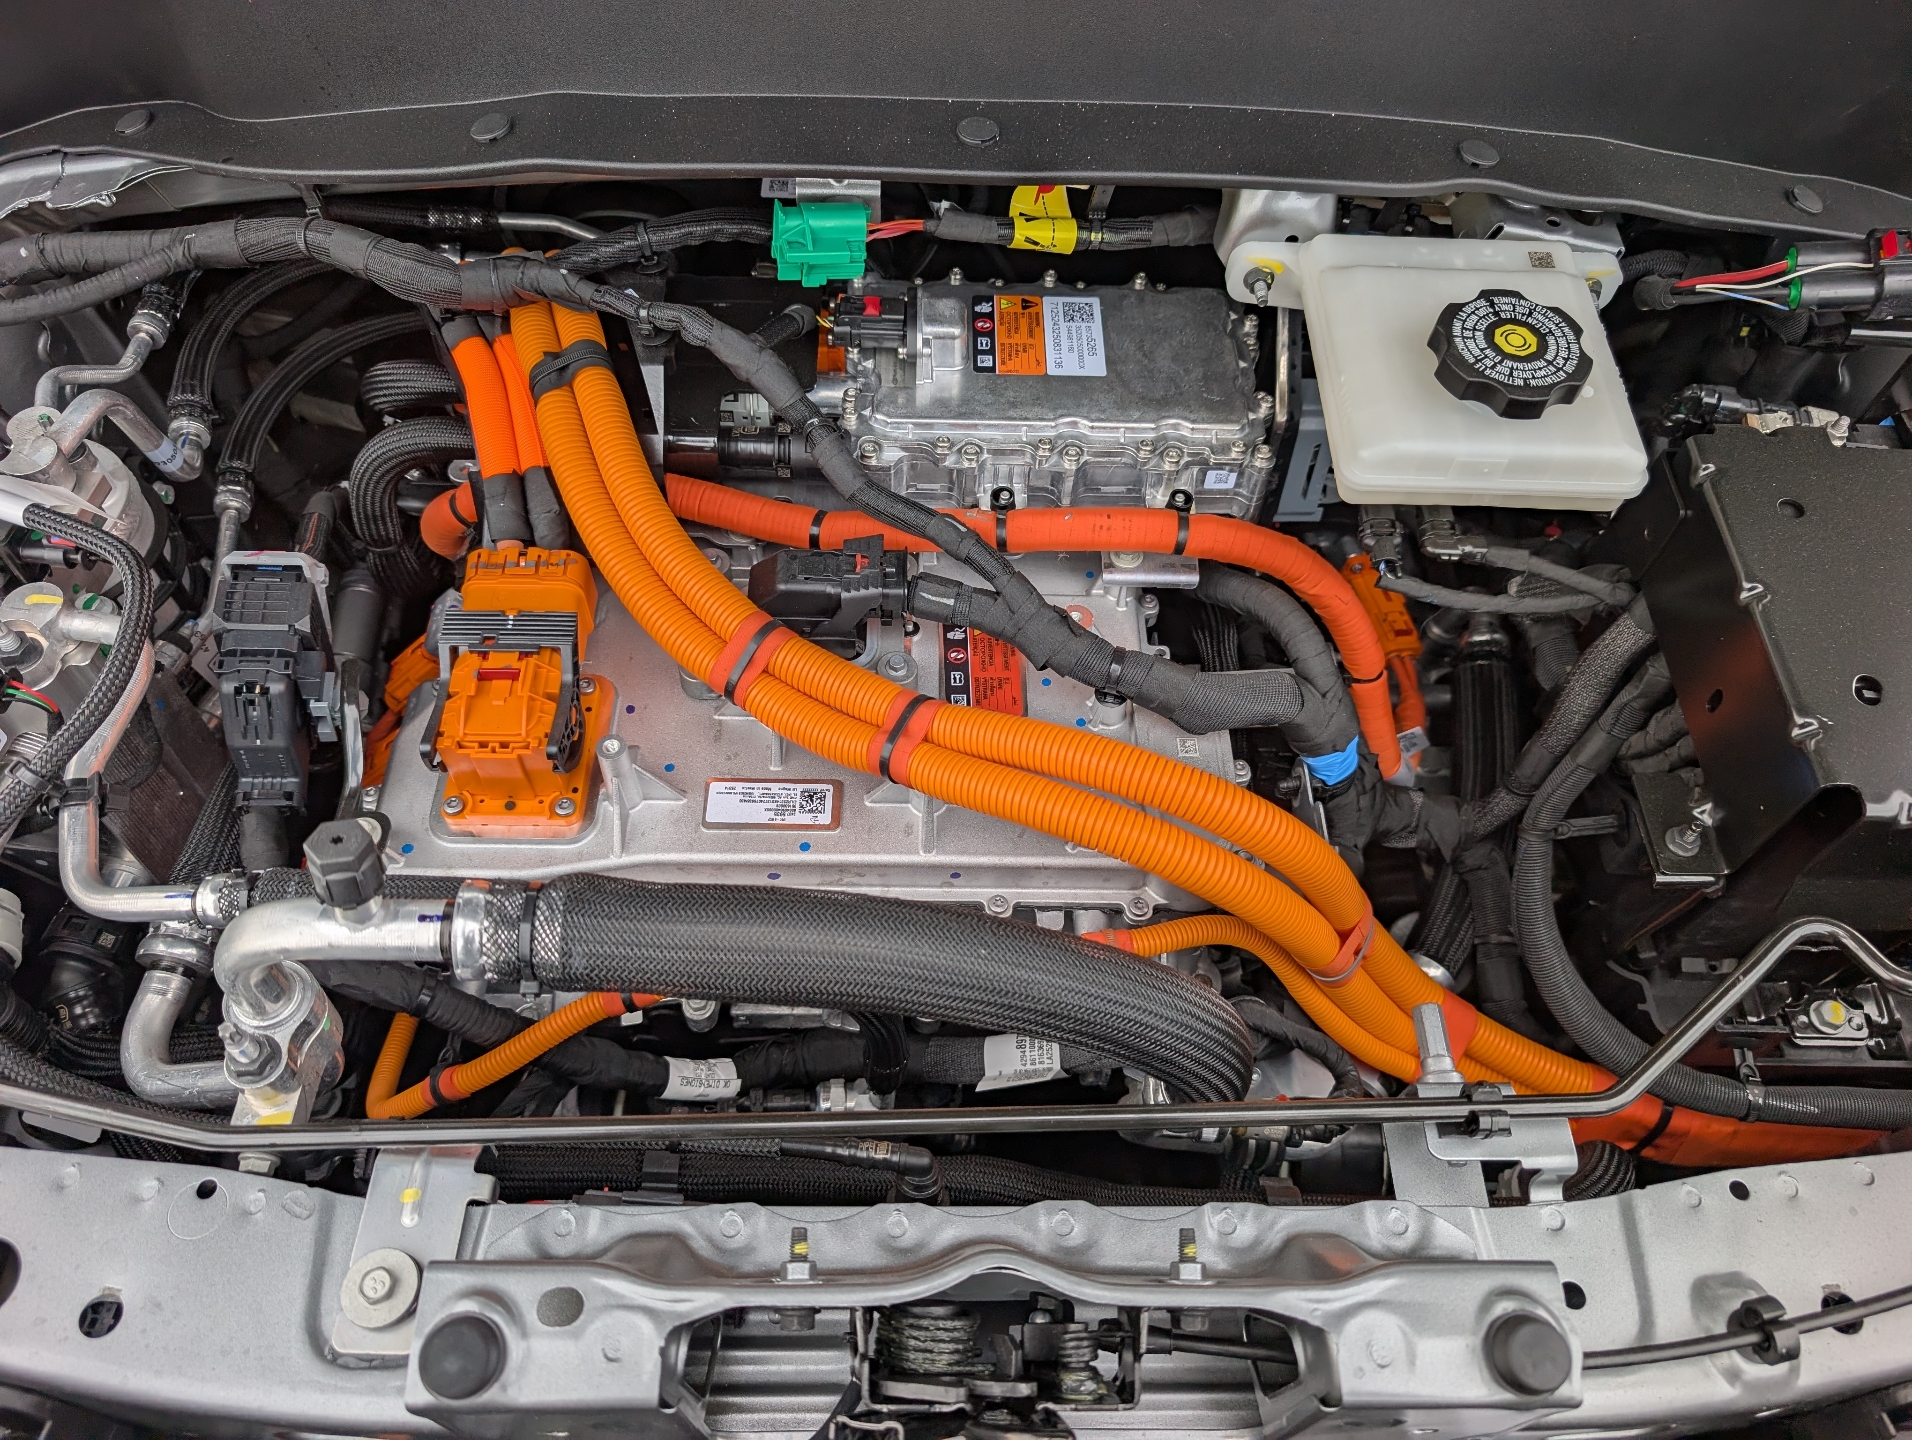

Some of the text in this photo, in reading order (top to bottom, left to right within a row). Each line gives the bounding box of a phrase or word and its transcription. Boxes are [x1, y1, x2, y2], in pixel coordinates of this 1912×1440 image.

[1456, 312, 1468, 320] LA
[1475, 306, 1494, 317] DOT4
[1500, 312, 1527, 321] FILLER
[1514, 305, 1529, 314] USE
[1536, 305, 1562, 323] SEALED
[1452, 318, 1463, 336] AVANT
[1526, 318, 1549, 333] CLEAN
[1561, 327, 1577, 342] FROM
[1453, 338, 1476, 364] BOUCHON
[1464, 338, 1484, 360] LIQUIDE
[1557, 336, 1569, 358] BEFORE
[1570, 343, 1580, 359] FLUID
[1474, 362, 1486, 371] LE
[1482, 358, 1494, 368] DU
[1494, 364, 1511, 374] QUE
[1502, 359, 1547, 370] PROVENANT
[1553, 356, 1565, 368] CAP
[1563, 359, 1579, 374] DOT4
[1484, 368, 1524, 386] NETTOYER
